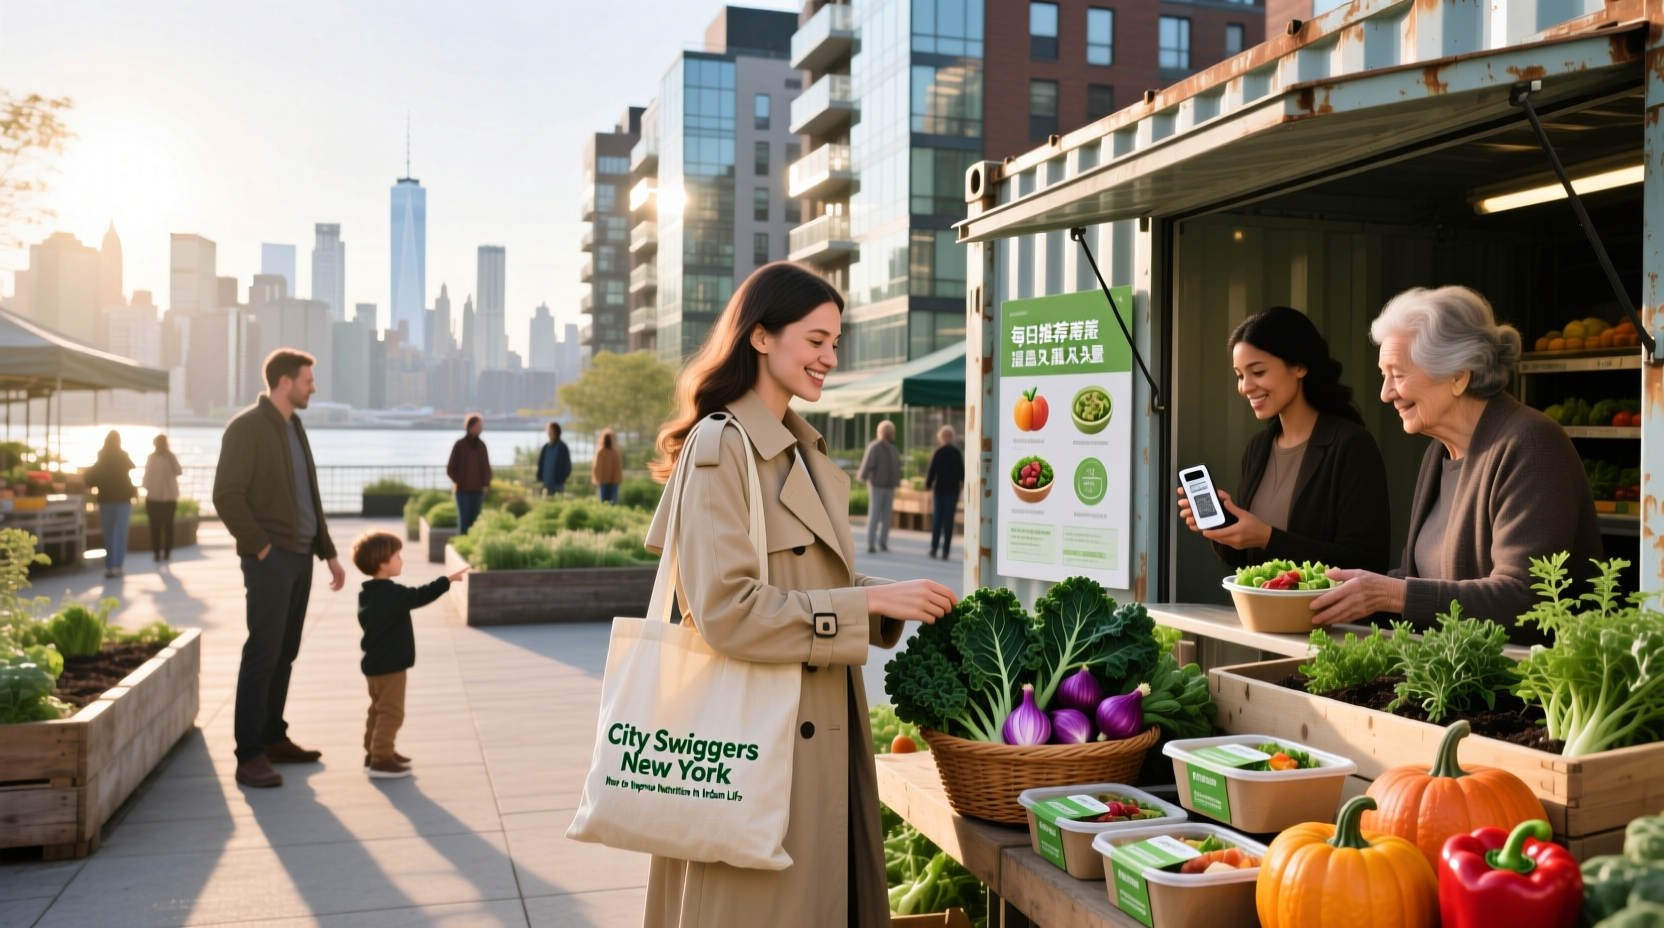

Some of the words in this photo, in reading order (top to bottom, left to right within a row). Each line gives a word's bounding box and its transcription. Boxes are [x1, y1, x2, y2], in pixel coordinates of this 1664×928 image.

[608, 723, 651, 754] City
[653, 729, 759, 763] Swiggers
[620, 751, 673, 778] New
[678, 759, 732, 784] York
